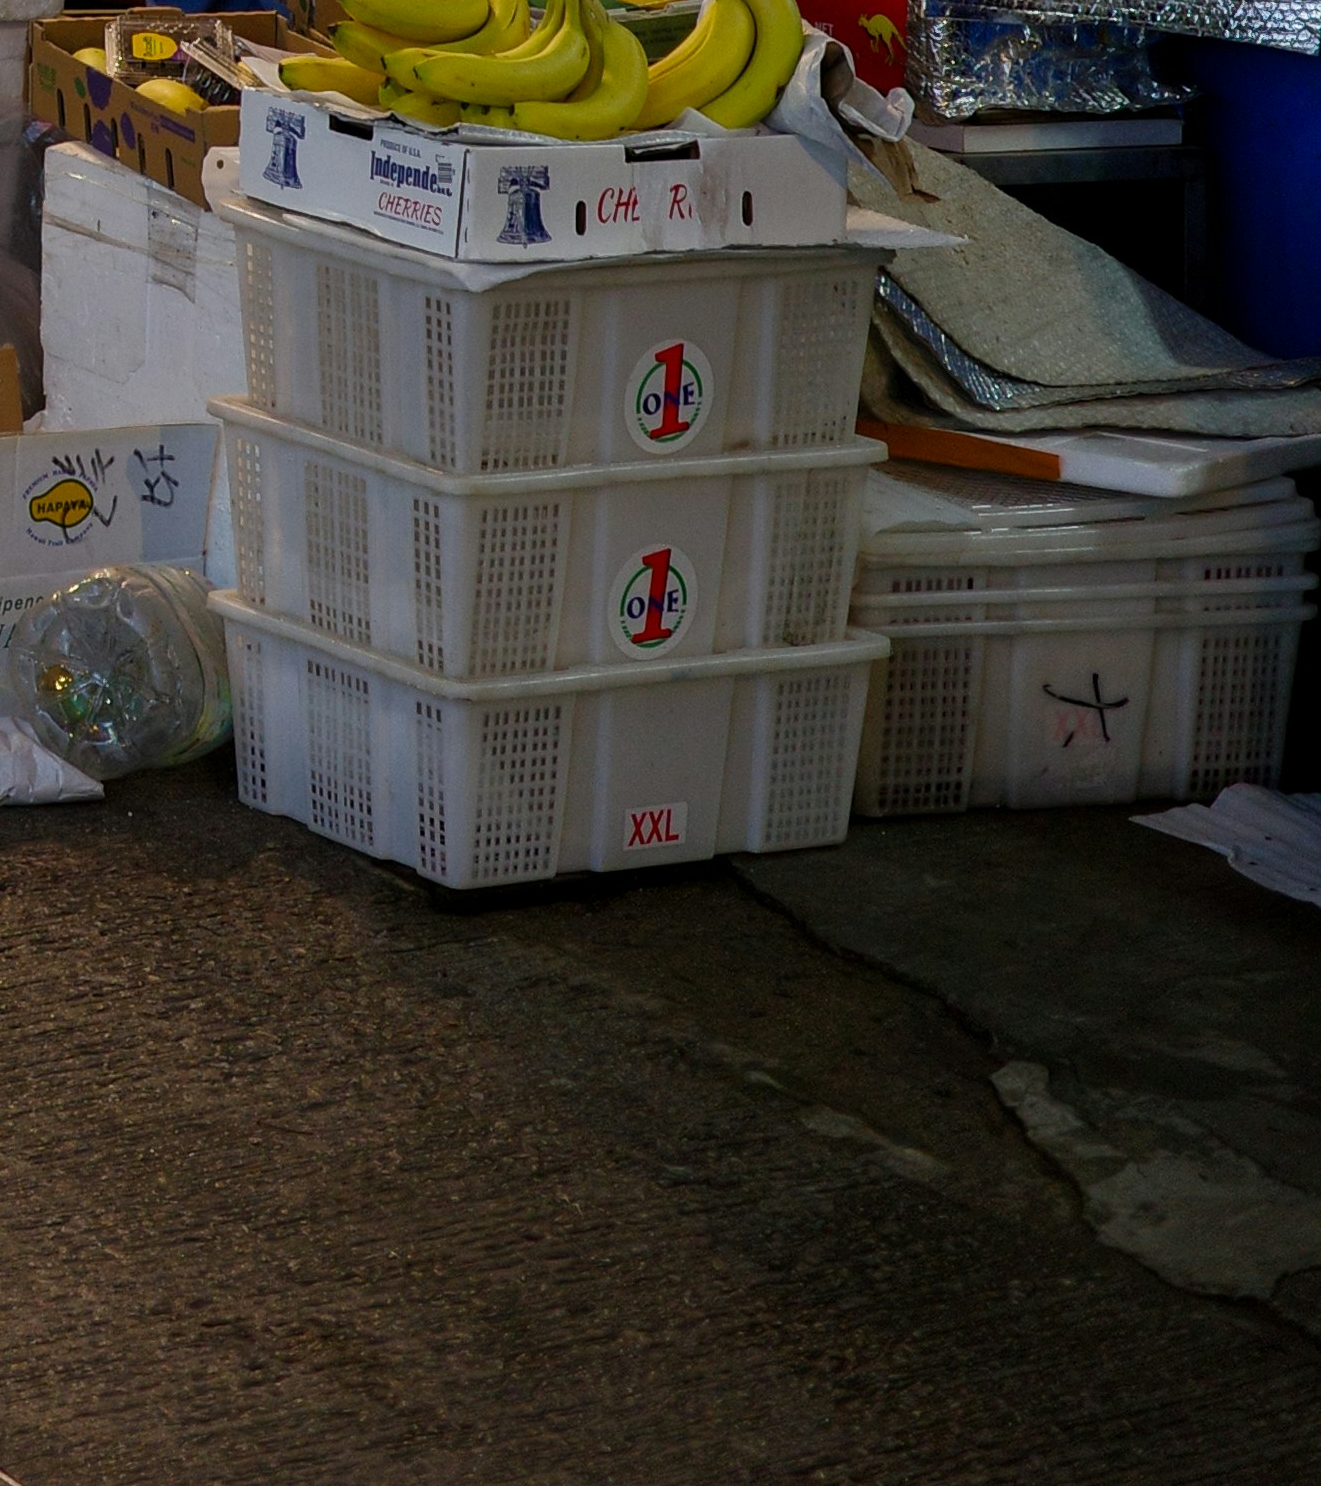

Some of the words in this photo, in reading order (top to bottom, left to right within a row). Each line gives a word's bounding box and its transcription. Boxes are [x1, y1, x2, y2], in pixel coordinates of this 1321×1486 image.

[378, 192, 443, 227] CHERRIES
[642, 381, 696, 416] ONE
[626, 589, 680, 620] ONE
[629, 809, 679, 848] XXL
